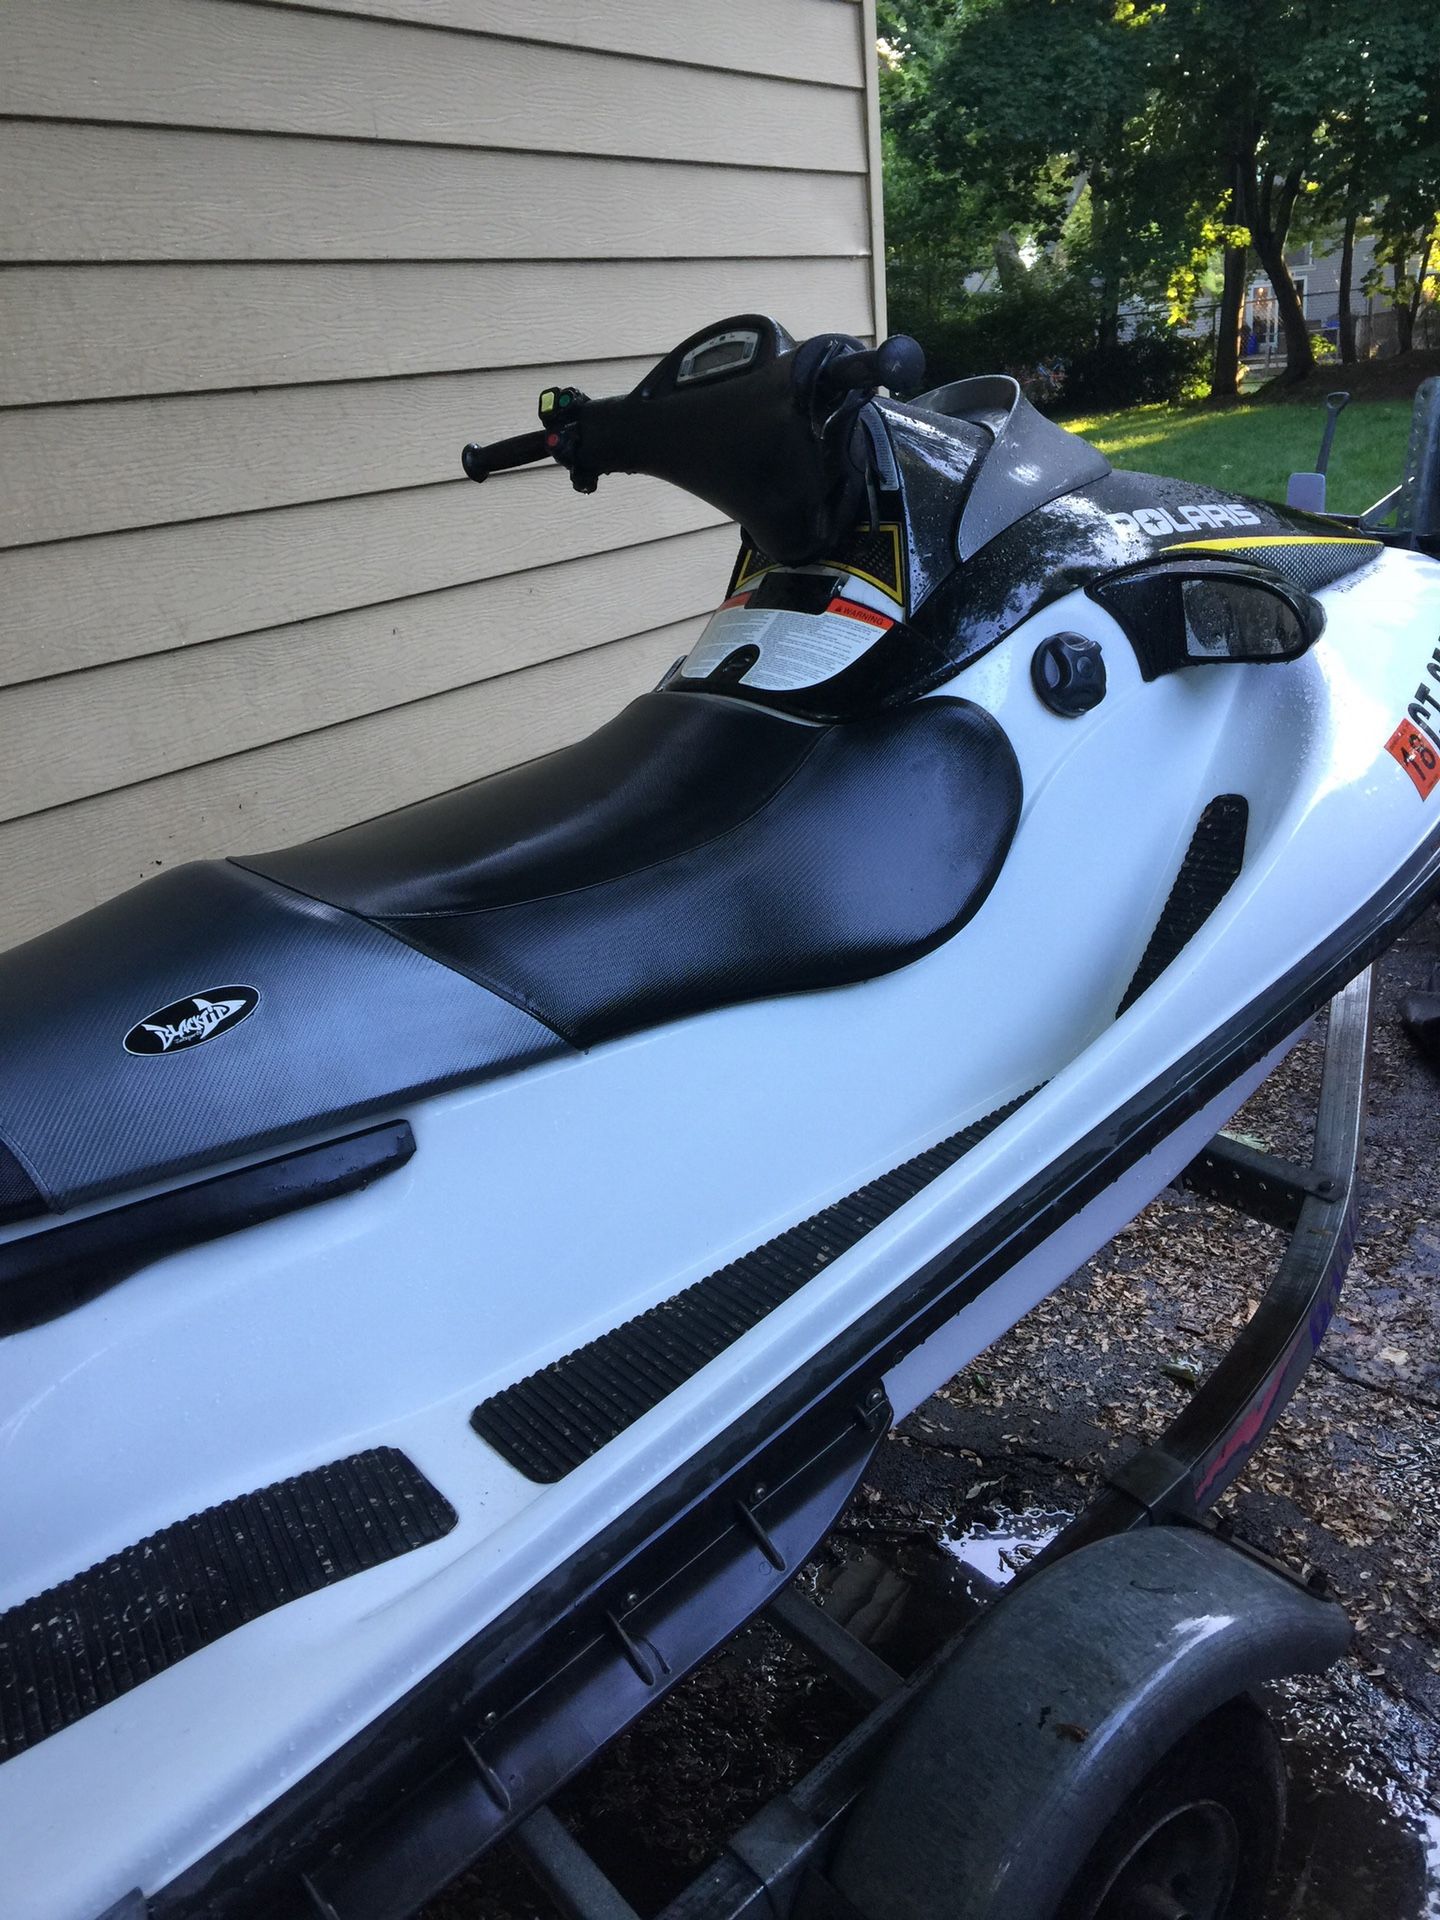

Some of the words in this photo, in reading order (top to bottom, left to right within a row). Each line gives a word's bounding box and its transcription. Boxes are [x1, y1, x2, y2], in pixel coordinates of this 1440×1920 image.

[1106, 504, 1261, 538] POLARIS
[843, 607, 884, 626] WARNING
[1401, 733, 1436, 781] 18
